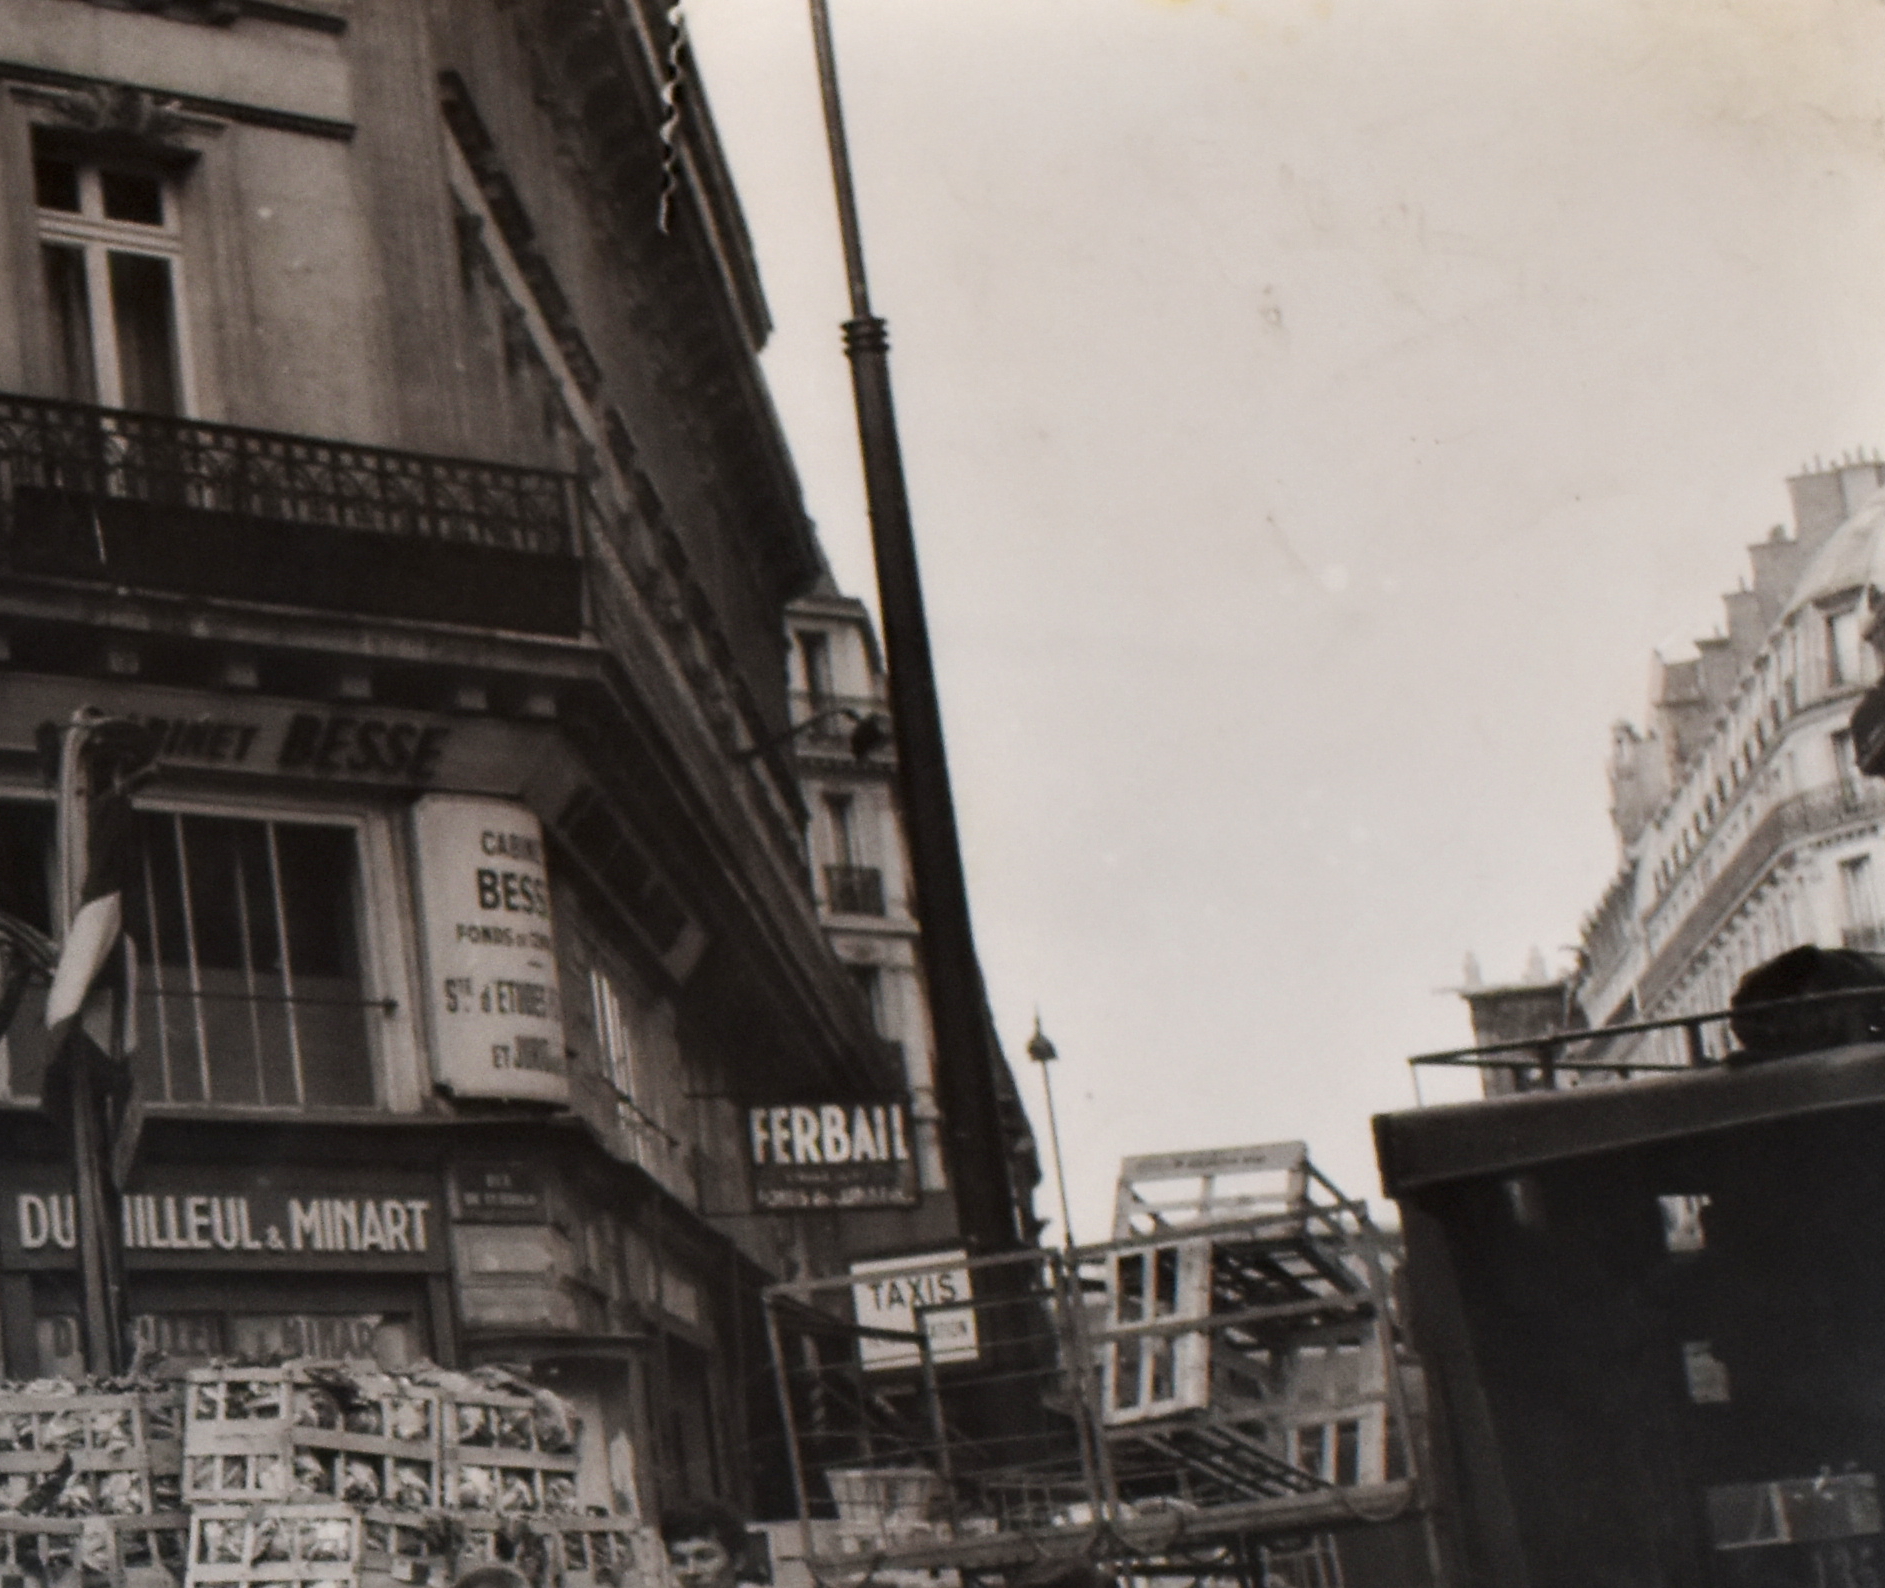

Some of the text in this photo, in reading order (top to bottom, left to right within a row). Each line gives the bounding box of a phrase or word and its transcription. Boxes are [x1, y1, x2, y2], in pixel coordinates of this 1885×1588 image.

[279, 712, 451, 781] BESSE
[748, 1102, 910, 1166] FERBAIL
[19, 1193, 430, 1253] DUILLEUL & MINART
[868, 1272, 957, 1312] TAXIS
